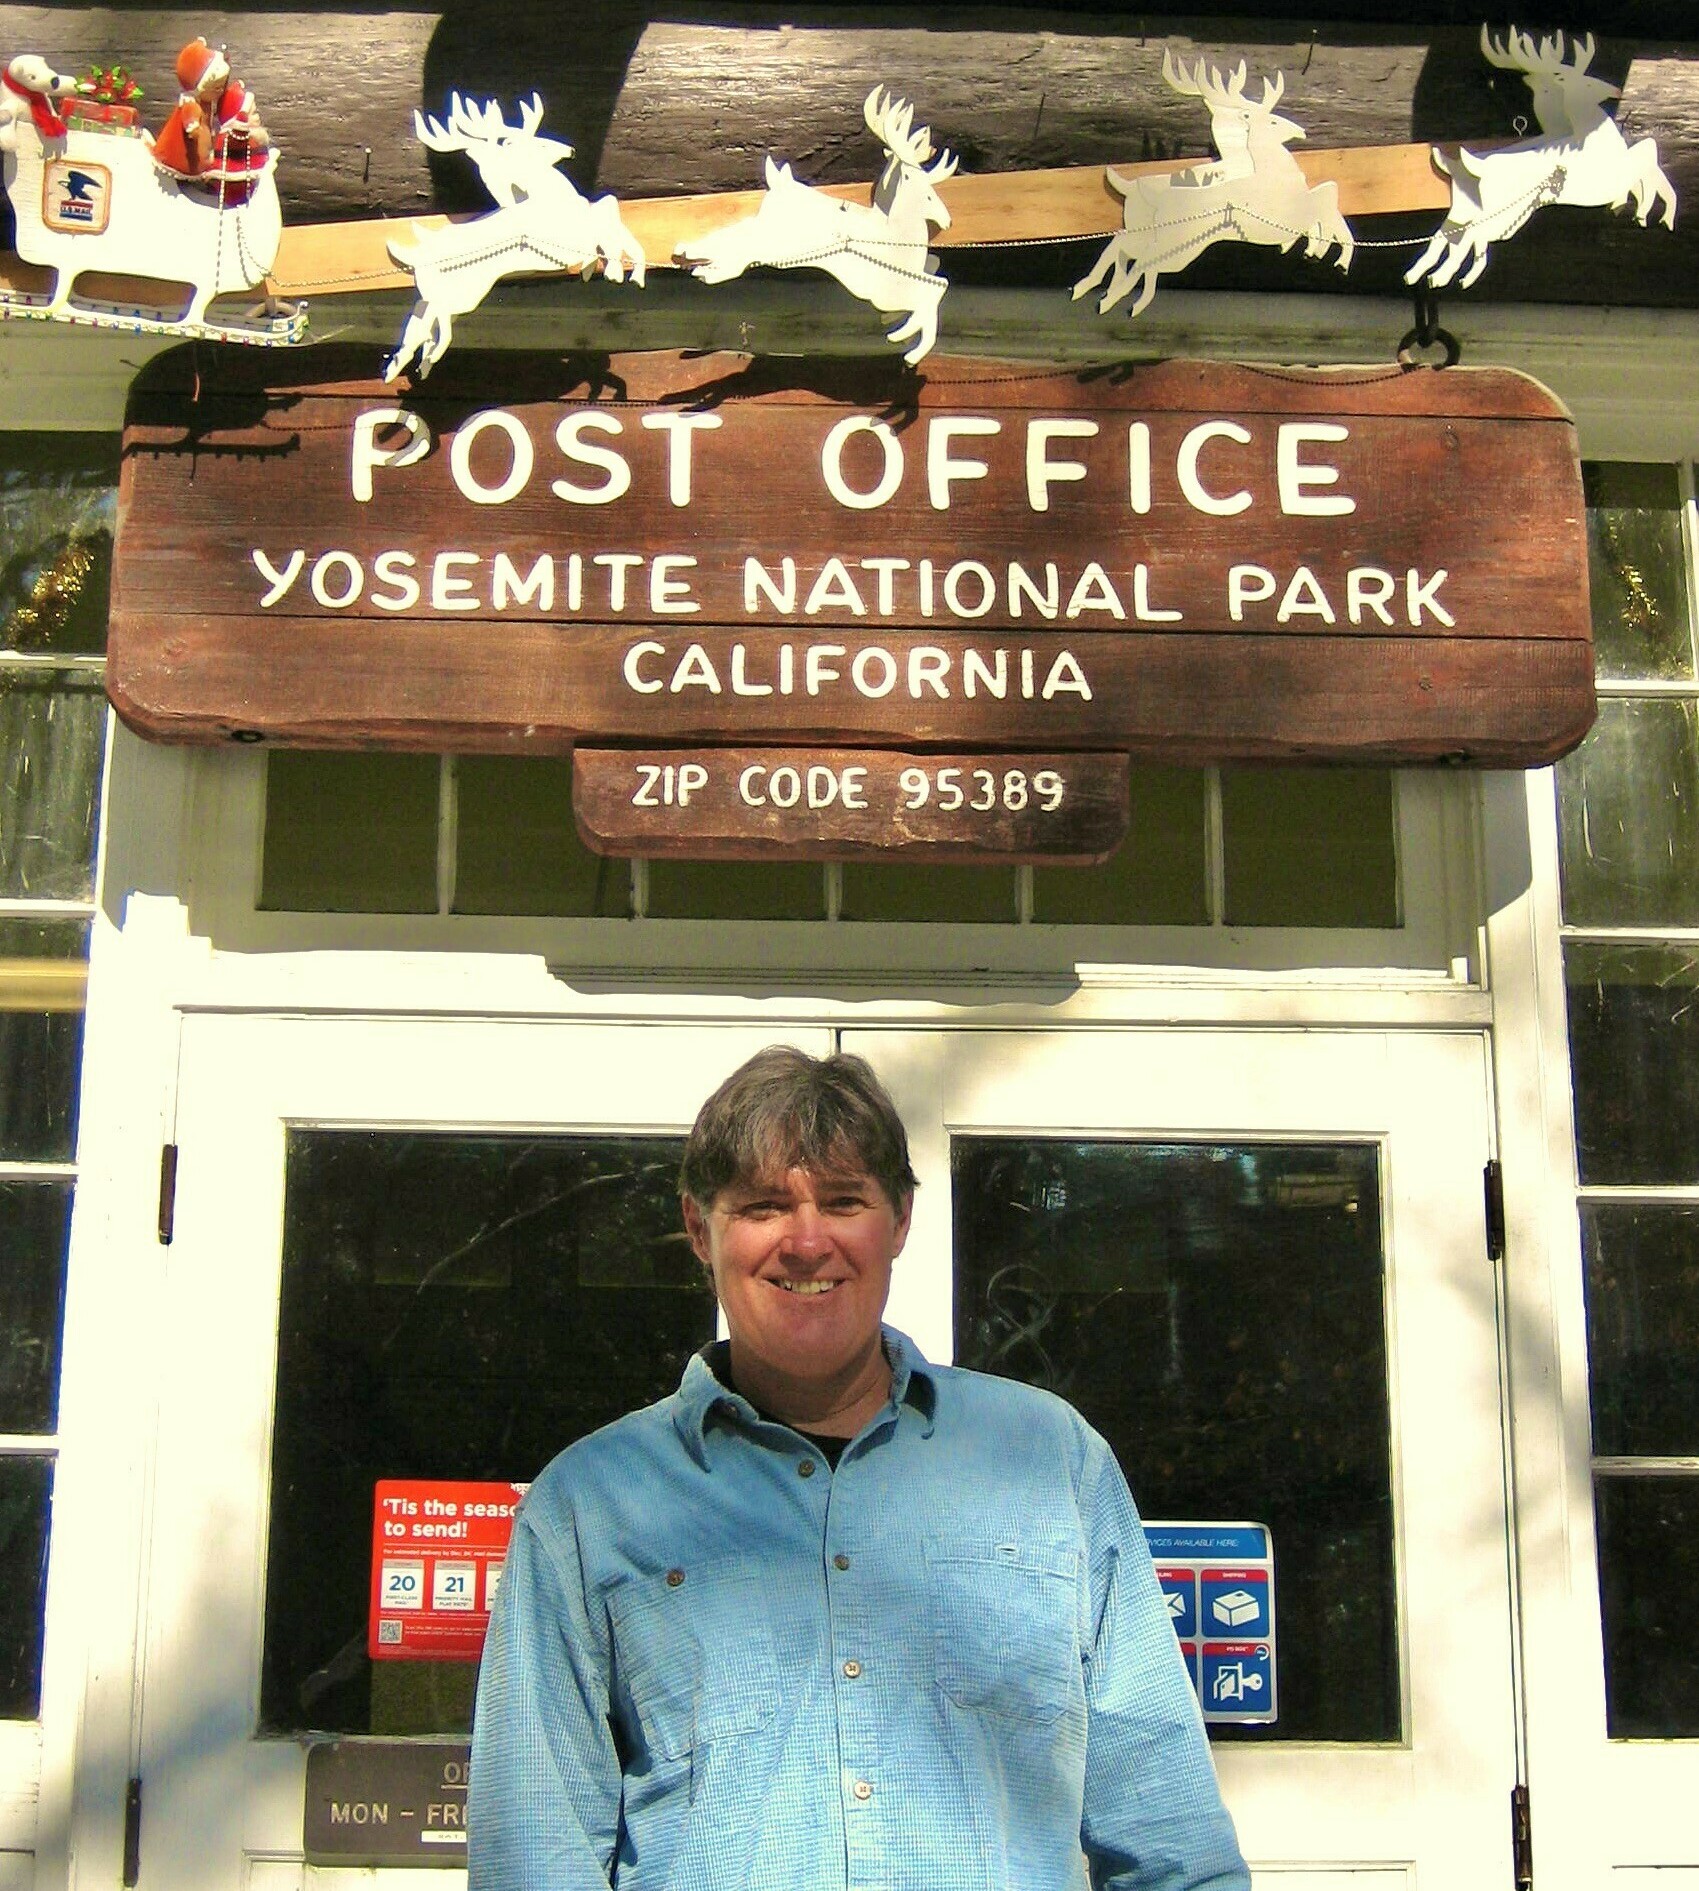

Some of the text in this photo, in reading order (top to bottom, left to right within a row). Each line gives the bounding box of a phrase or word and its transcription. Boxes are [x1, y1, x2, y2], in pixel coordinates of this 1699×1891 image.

[352, 409, 1355, 515] POST OFFICE
[253, 550, 1456, 627] YOSEMITE NATIONAL PARK
[624, 641, 1092, 701] CALIFORNIA
[632, 765, 1063, 812] ZIP CODE 95389
[424, 1499, 458, 1516] the
[384, 1521, 468, 1538] to send!
[1173, 1539, 1214, 1547] AVAILABLE
[389, 1575, 416, 1591] 20
[445, 1577, 465, 1592] 21
[331, 1802, 389, 1824] MON
[426, 1803, 468, 1825] FRI
